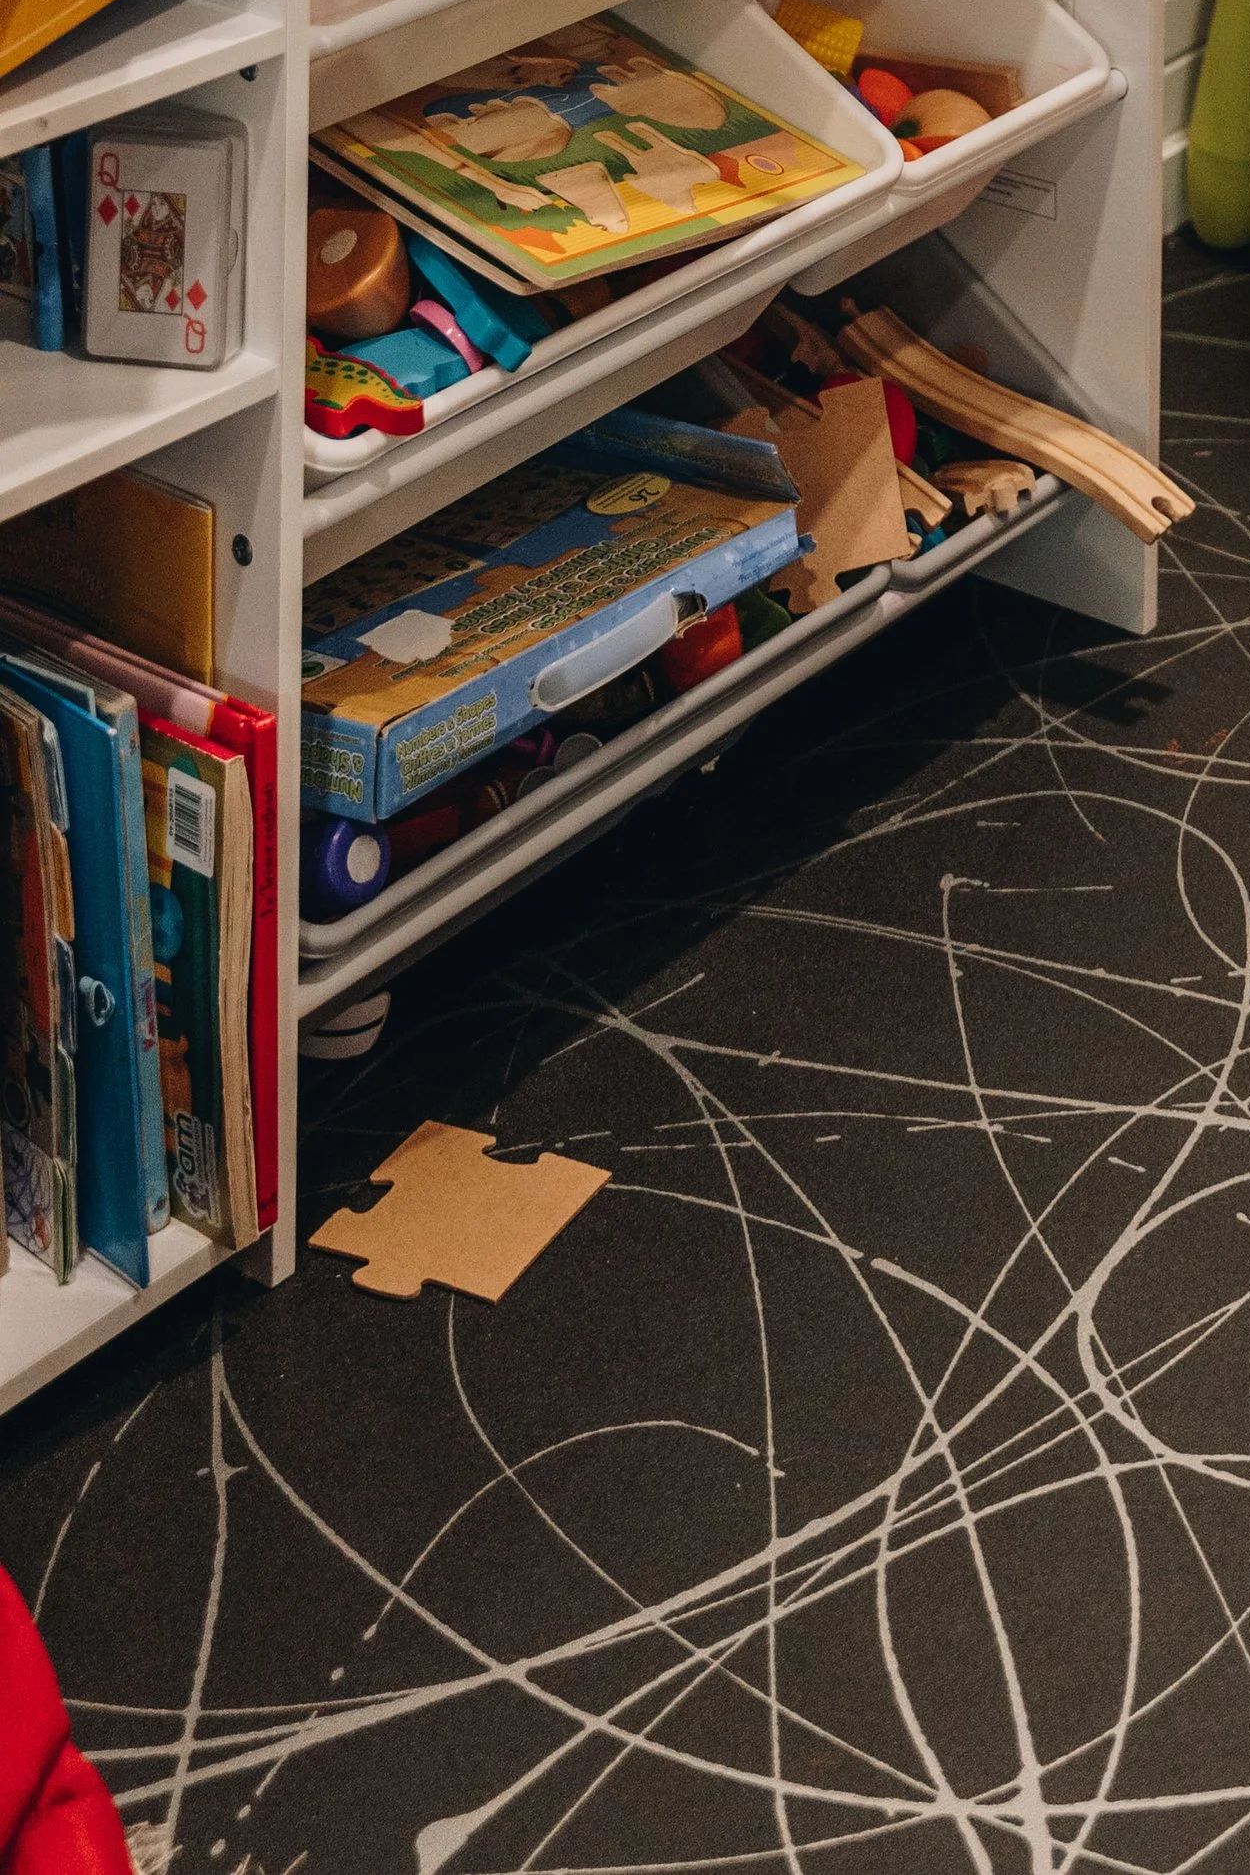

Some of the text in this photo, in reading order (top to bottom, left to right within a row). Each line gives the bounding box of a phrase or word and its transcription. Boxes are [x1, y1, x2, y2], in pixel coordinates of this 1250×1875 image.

[98, 152, 123, 192] Q
[183, 313, 208, 355] Q
[396, 722, 446, 759] Numbers
[455, 693, 496, 725] Shapes
[302, 768, 363, 802] Numbe
